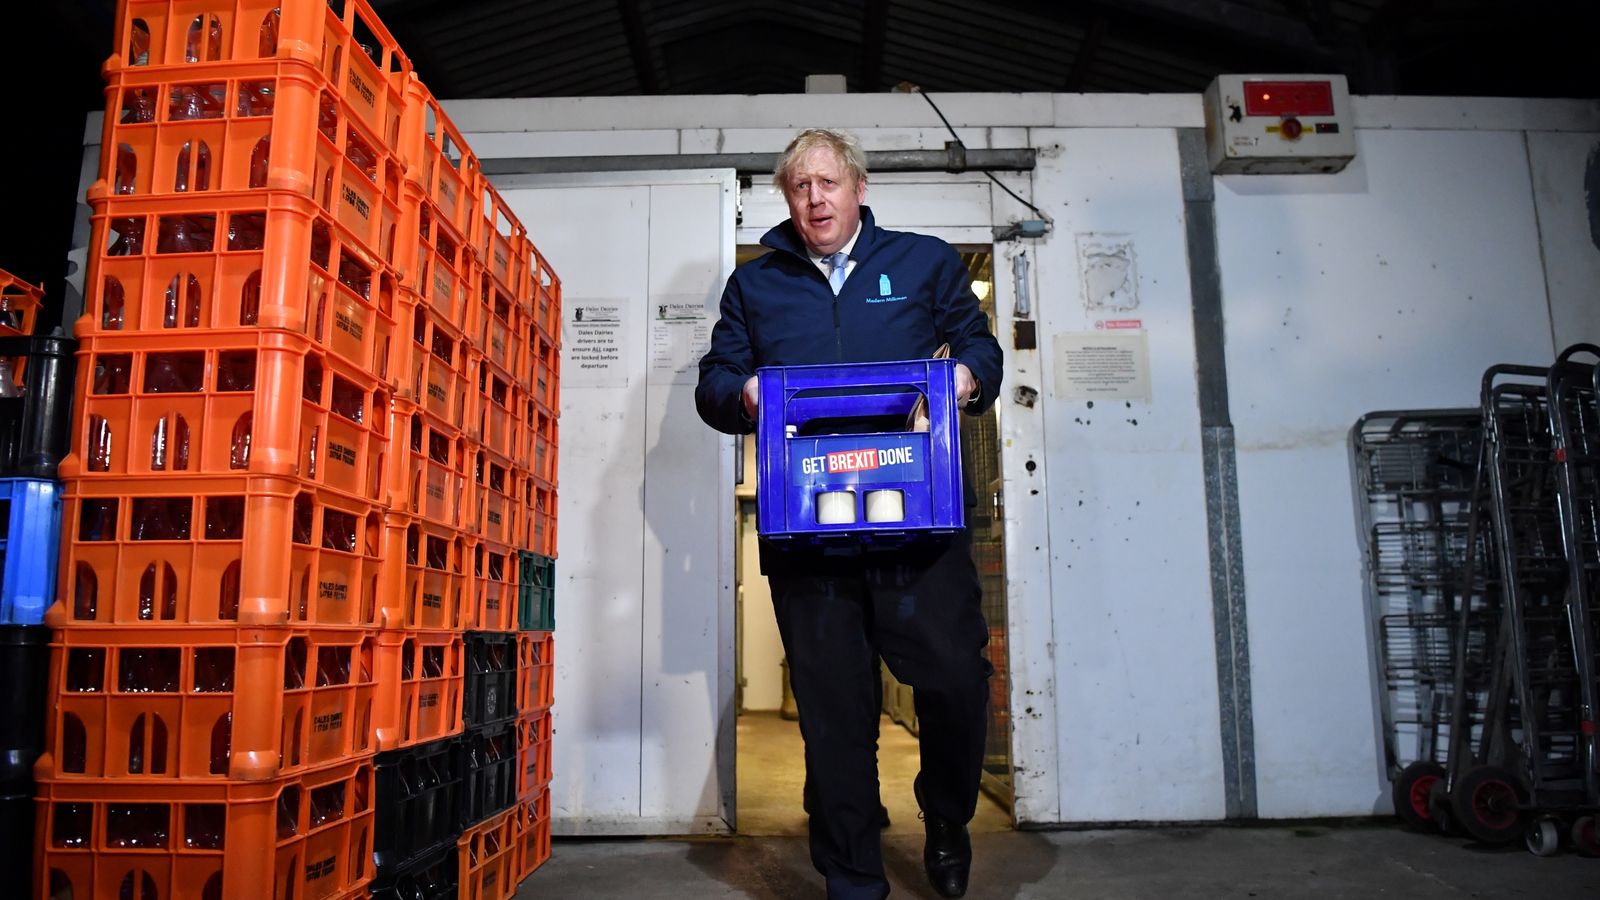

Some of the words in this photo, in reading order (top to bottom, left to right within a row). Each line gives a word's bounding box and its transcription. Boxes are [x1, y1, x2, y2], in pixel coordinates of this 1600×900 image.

[802, 456, 826, 474] GET
[829, 450, 875, 471] BREXIT
[878, 446, 914, 466] DONE
